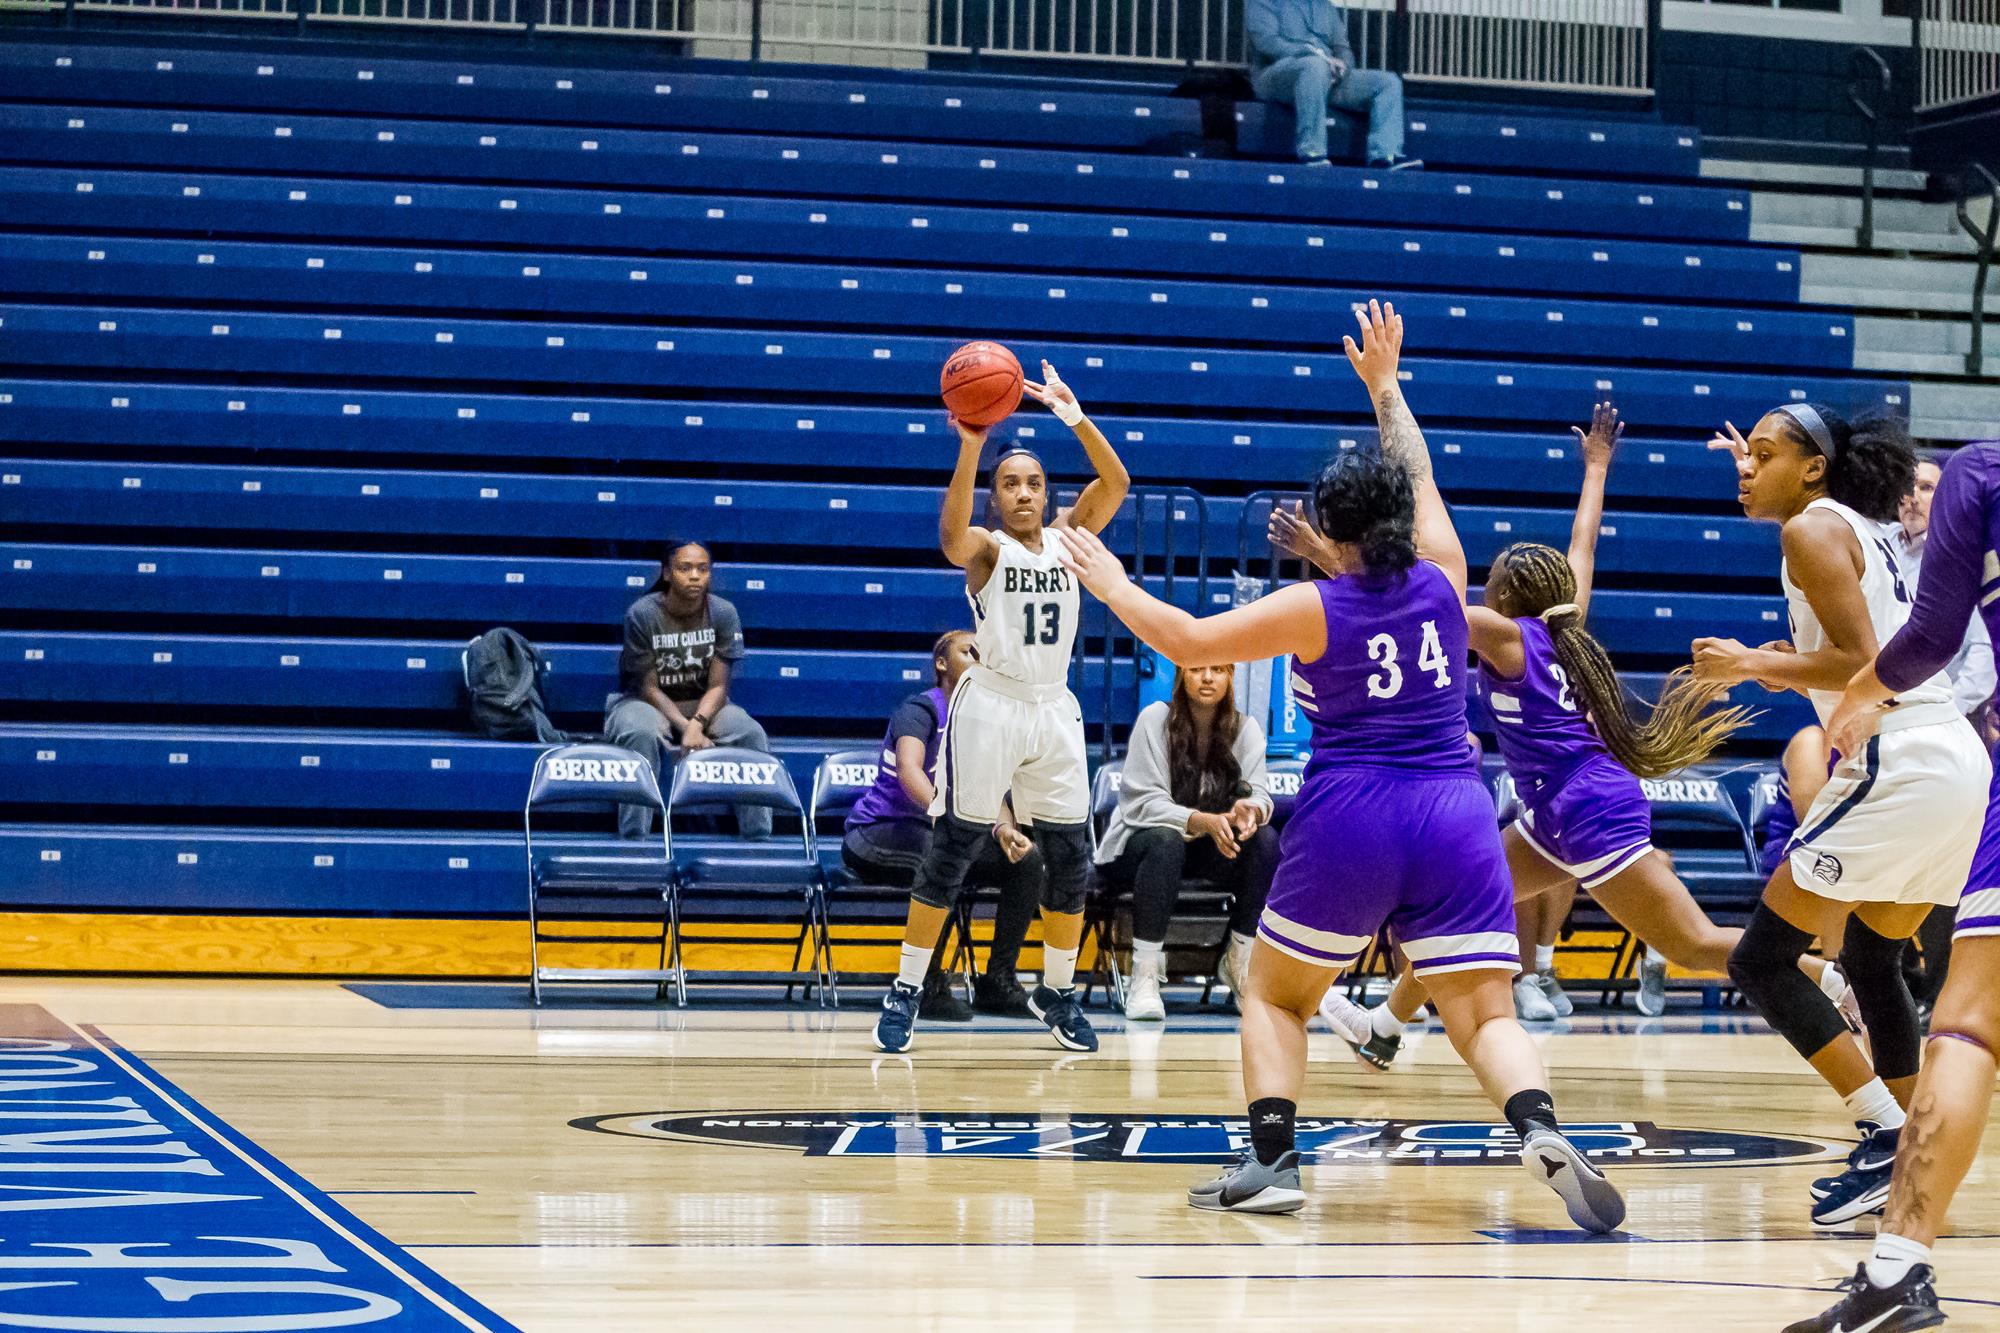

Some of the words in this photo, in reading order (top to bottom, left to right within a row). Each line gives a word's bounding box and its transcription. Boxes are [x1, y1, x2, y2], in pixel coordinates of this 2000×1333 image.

[1004, 566, 1071, 593] BERRY
[1023, 602, 1060, 646] 13
[681, 628, 716, 647] COLLEG
[1367, 620, 1452, 699] 34
[547, 759, 641, 783] BERRY
[687, 760, 779, 785] BERRY
[829, 764, 879, 787] BER
[1640, 779, 1719, 803] BERRY
[701, 1118, 1108, 1128] ASSOCIATION
[1332, 1147, 1737, 1158] SOUHERN
